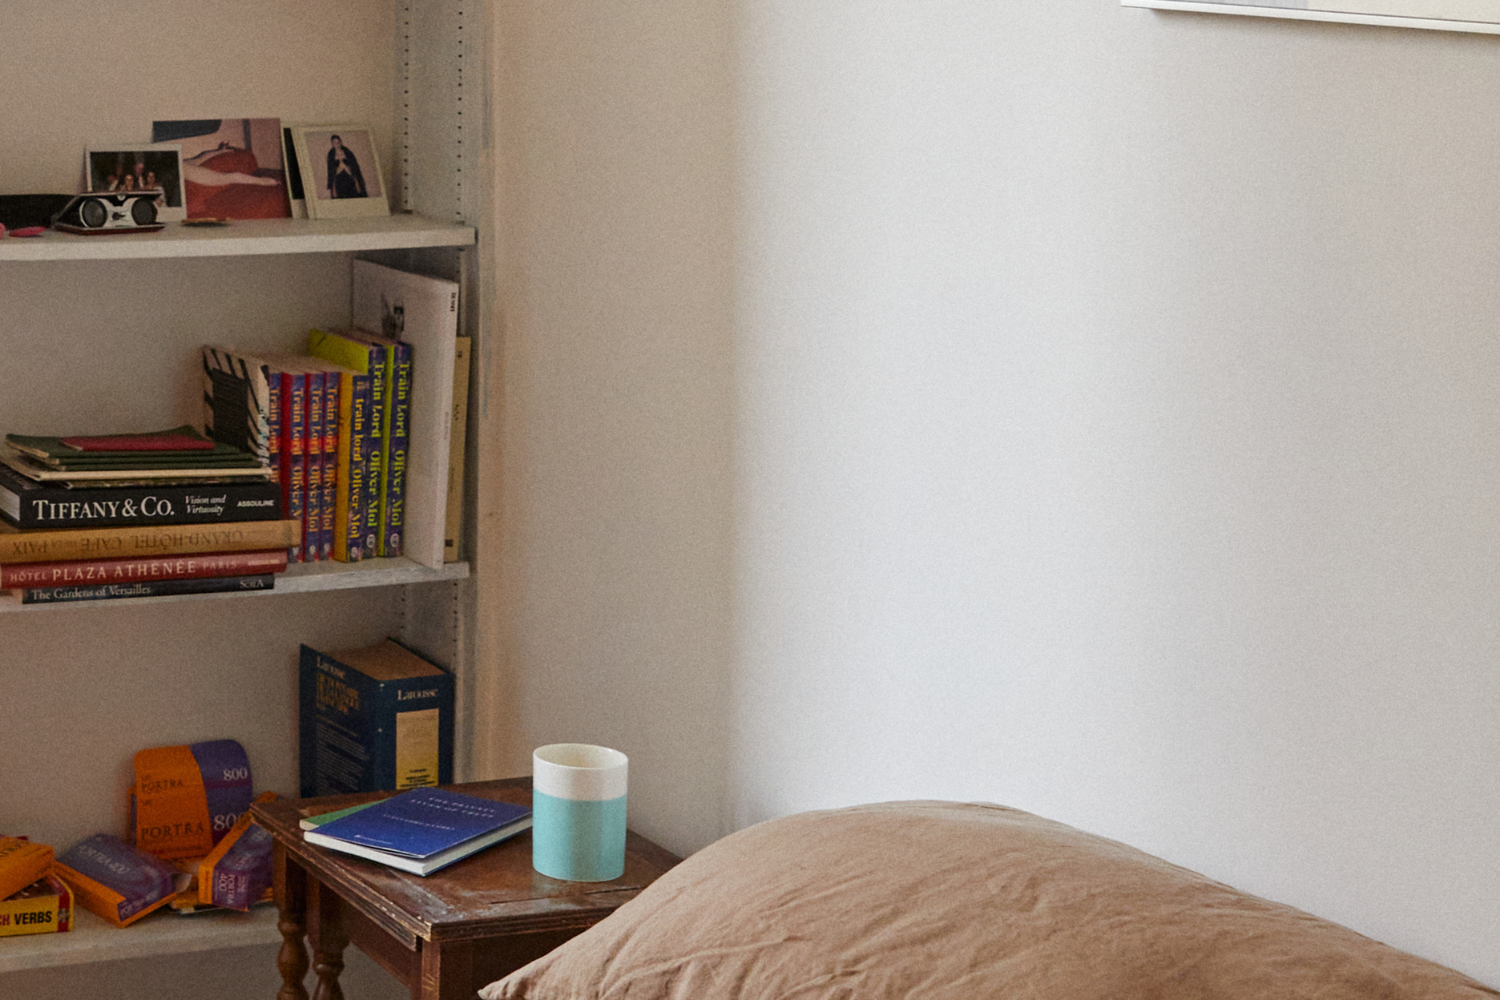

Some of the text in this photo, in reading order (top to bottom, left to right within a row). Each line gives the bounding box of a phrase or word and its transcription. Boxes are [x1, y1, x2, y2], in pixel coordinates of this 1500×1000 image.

[270, 388, 280, 421] Train
[292, 389, 304, 423] Train
[268, 425, 279, 454] Lord
[291, 426, 304, 455] Lord
[367, 361, 385, 528] Train Lord Oliver Mol
[391, 361, 410, 527] Train Lord Oliver Mol
[307, 388, 323, 533] Train Lord Oliver Mol
[322, 386, 339, 531] Train Lord Oliver Mol
[290, 466, 303, 507] Oliver
[350, 468, 363, 511] Oliver
[184, 494, 227, 505] Vision and
[186, 504, 225, 516] Virtuosity
[349, 512, 362, 539] Mol
[52, 566, 108, 582] PLAZA
[202, 561, 237, 571] PARIS
[32, 583, 151, 601] The Gardens of Versailles
[397, 688, 439, 701] Larousse
[141, 778, 184, 793] PORTRA
[223, 767, 248, 782] 800
[141, 822, 205, 840] PORTRA
[213, 811, 246, 832] 80
[219, 872, 228, 892] 400
[14, 911, 53, 926] VERBS
